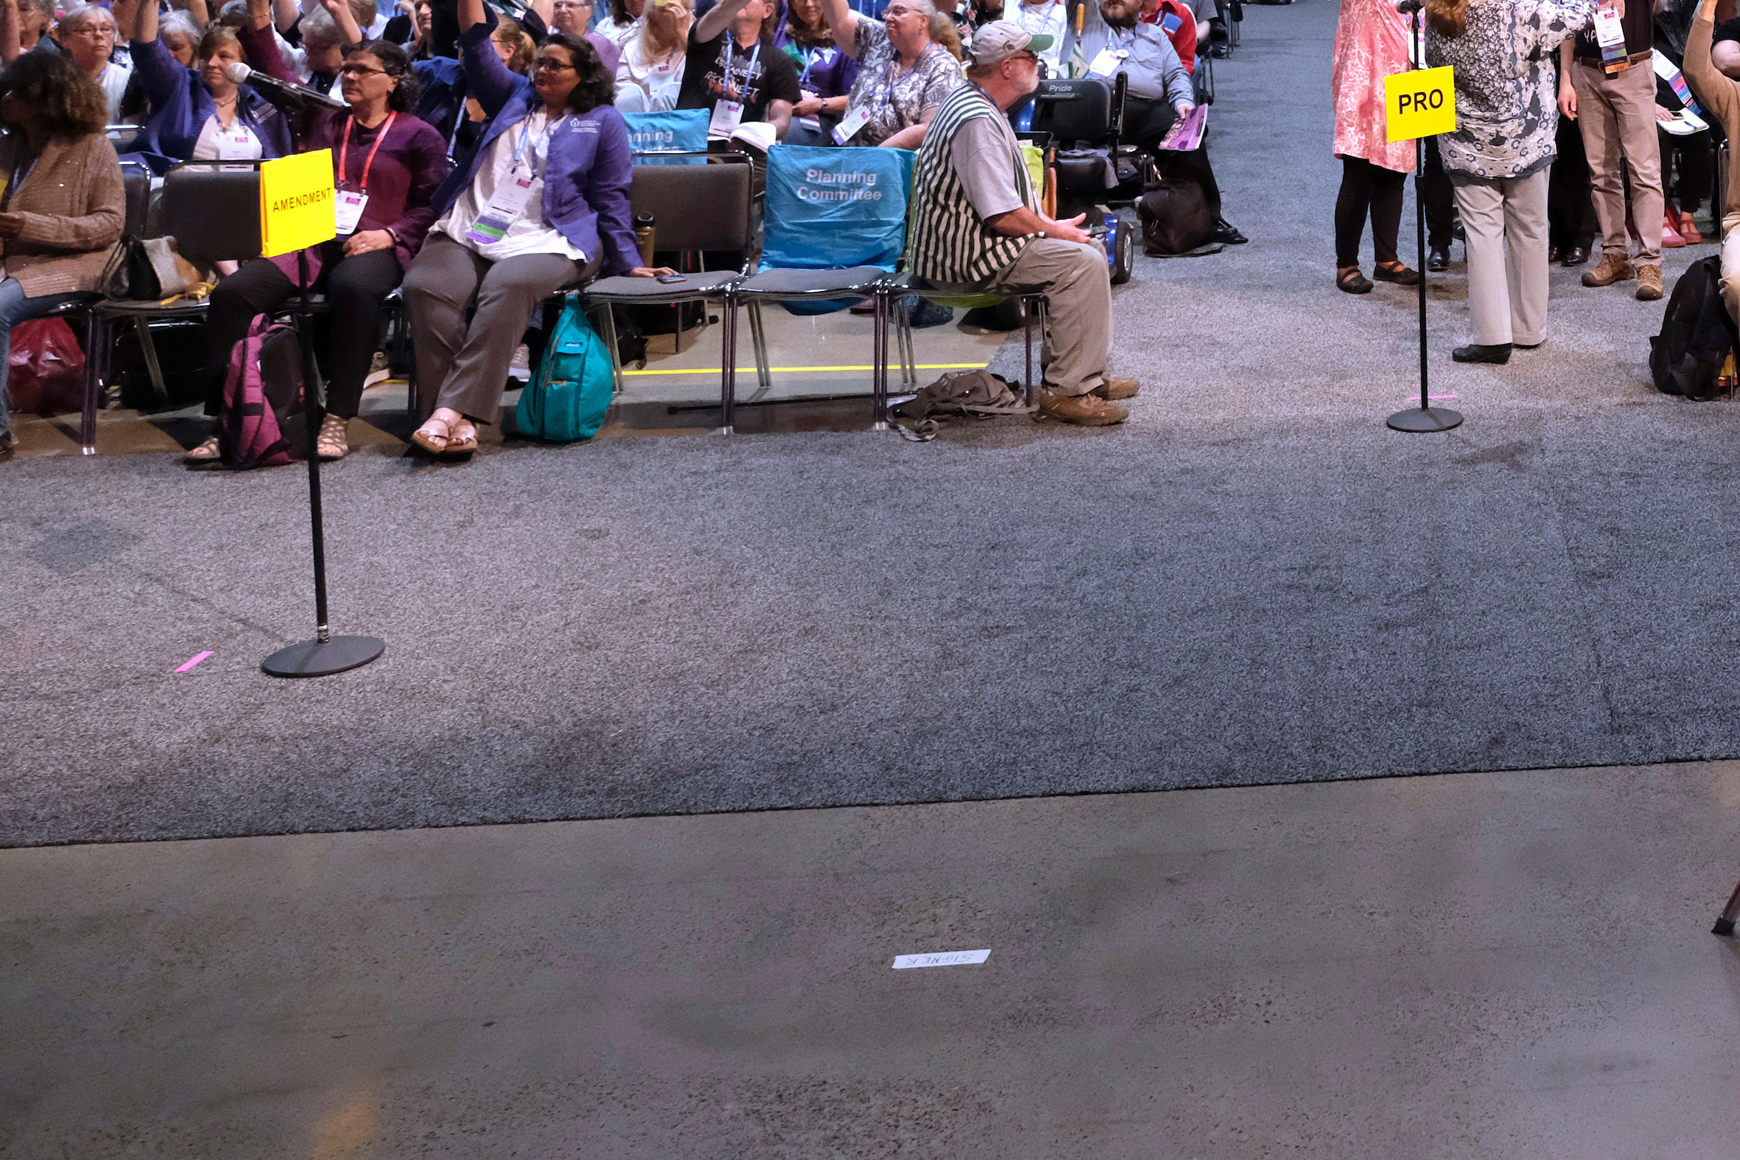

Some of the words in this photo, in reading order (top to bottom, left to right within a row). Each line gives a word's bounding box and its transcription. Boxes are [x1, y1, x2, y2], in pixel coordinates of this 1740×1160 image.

[1049, 84, 1072, 92] Pride
[1398, 88, 1444, 115] PRO
[627, 130, 674, 143] anning
[806, 169, 877, 185] Planning
[273, 187, 331, 213] AMENDMENT
[797, 186, 882, 201] Committee
